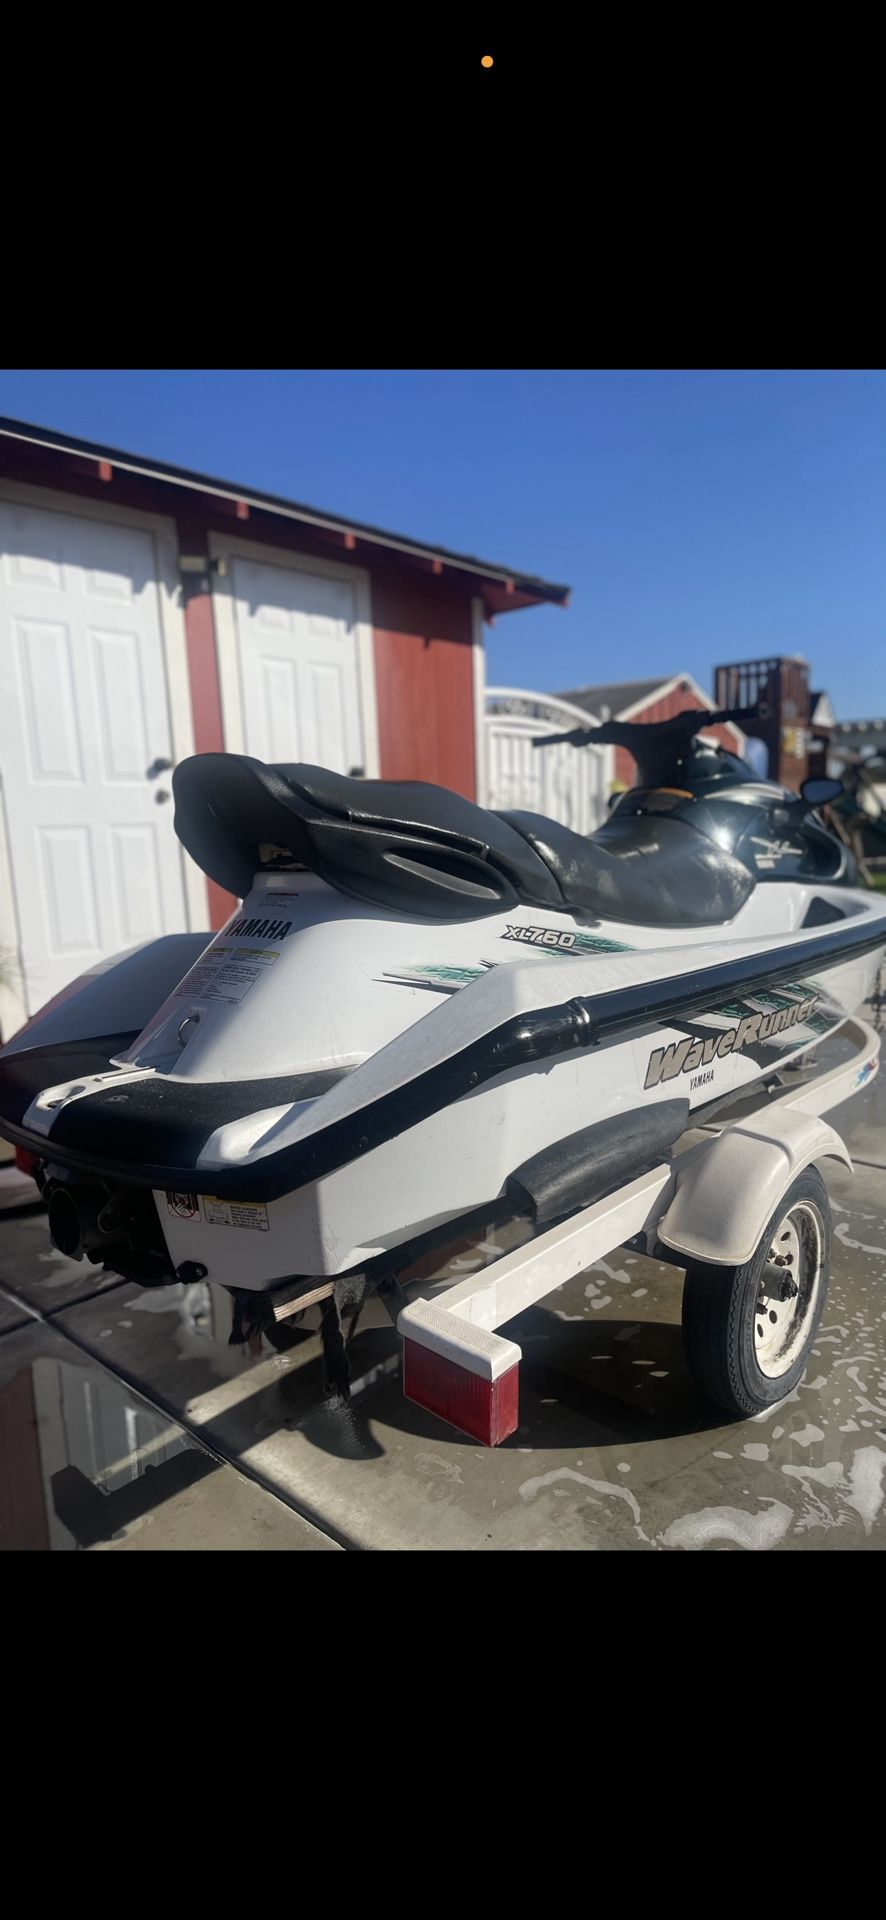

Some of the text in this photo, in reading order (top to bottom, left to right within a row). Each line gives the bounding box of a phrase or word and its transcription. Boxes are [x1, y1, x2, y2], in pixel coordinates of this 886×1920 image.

[225, 919, 293, 940] YAMAHA
[644, 996, 818, 1090] WaveRunner
[689, 1069, 715, 1091] YAMAHA
